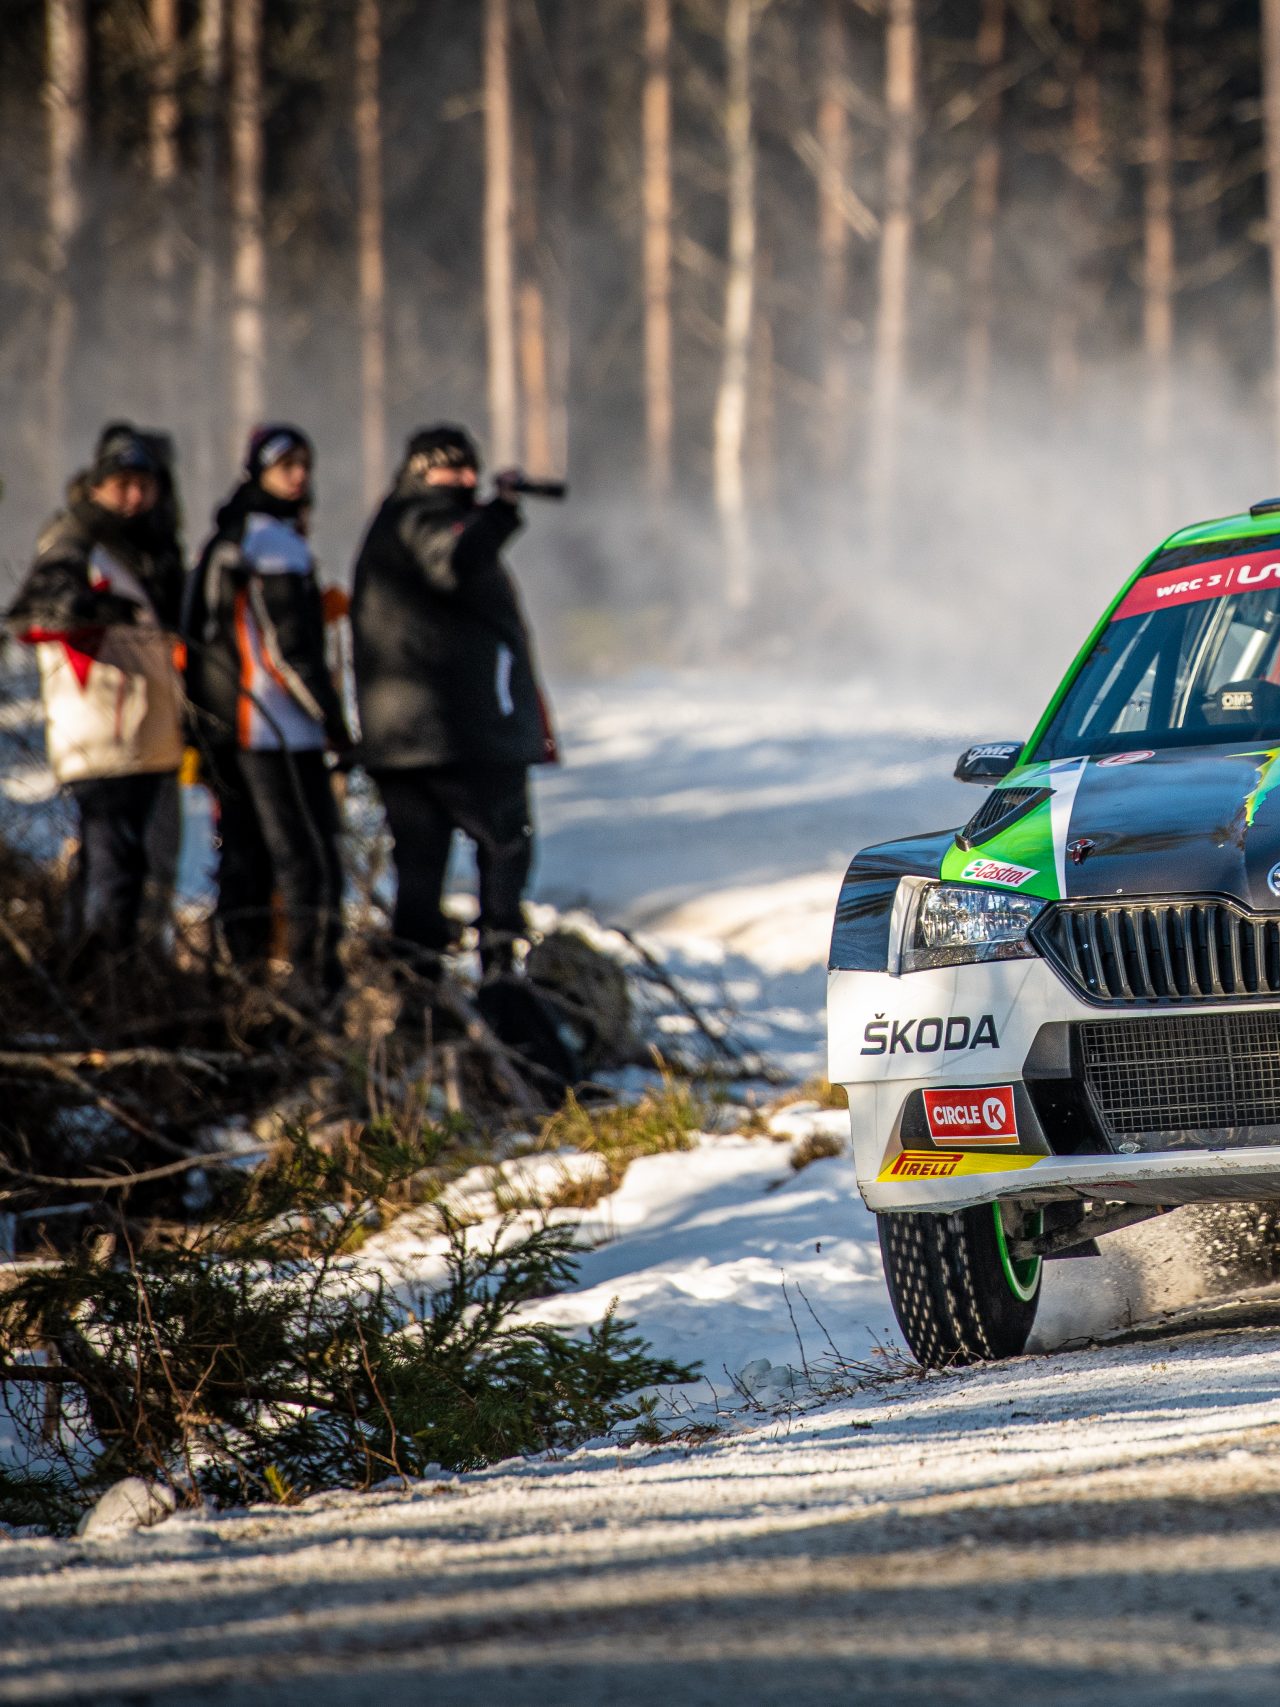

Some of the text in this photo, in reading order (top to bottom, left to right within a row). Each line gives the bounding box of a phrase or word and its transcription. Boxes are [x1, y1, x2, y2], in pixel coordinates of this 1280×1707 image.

[1156, 574, 1222, 598] WRC 3
[977, 860, 1035, 886] Castrol
[860, 1012, 1000, 1056] ŠKODA
[932, 1102, 1004, 1127] CIRCLE K
[891, 1151, 964, 1176] PIRELLI
